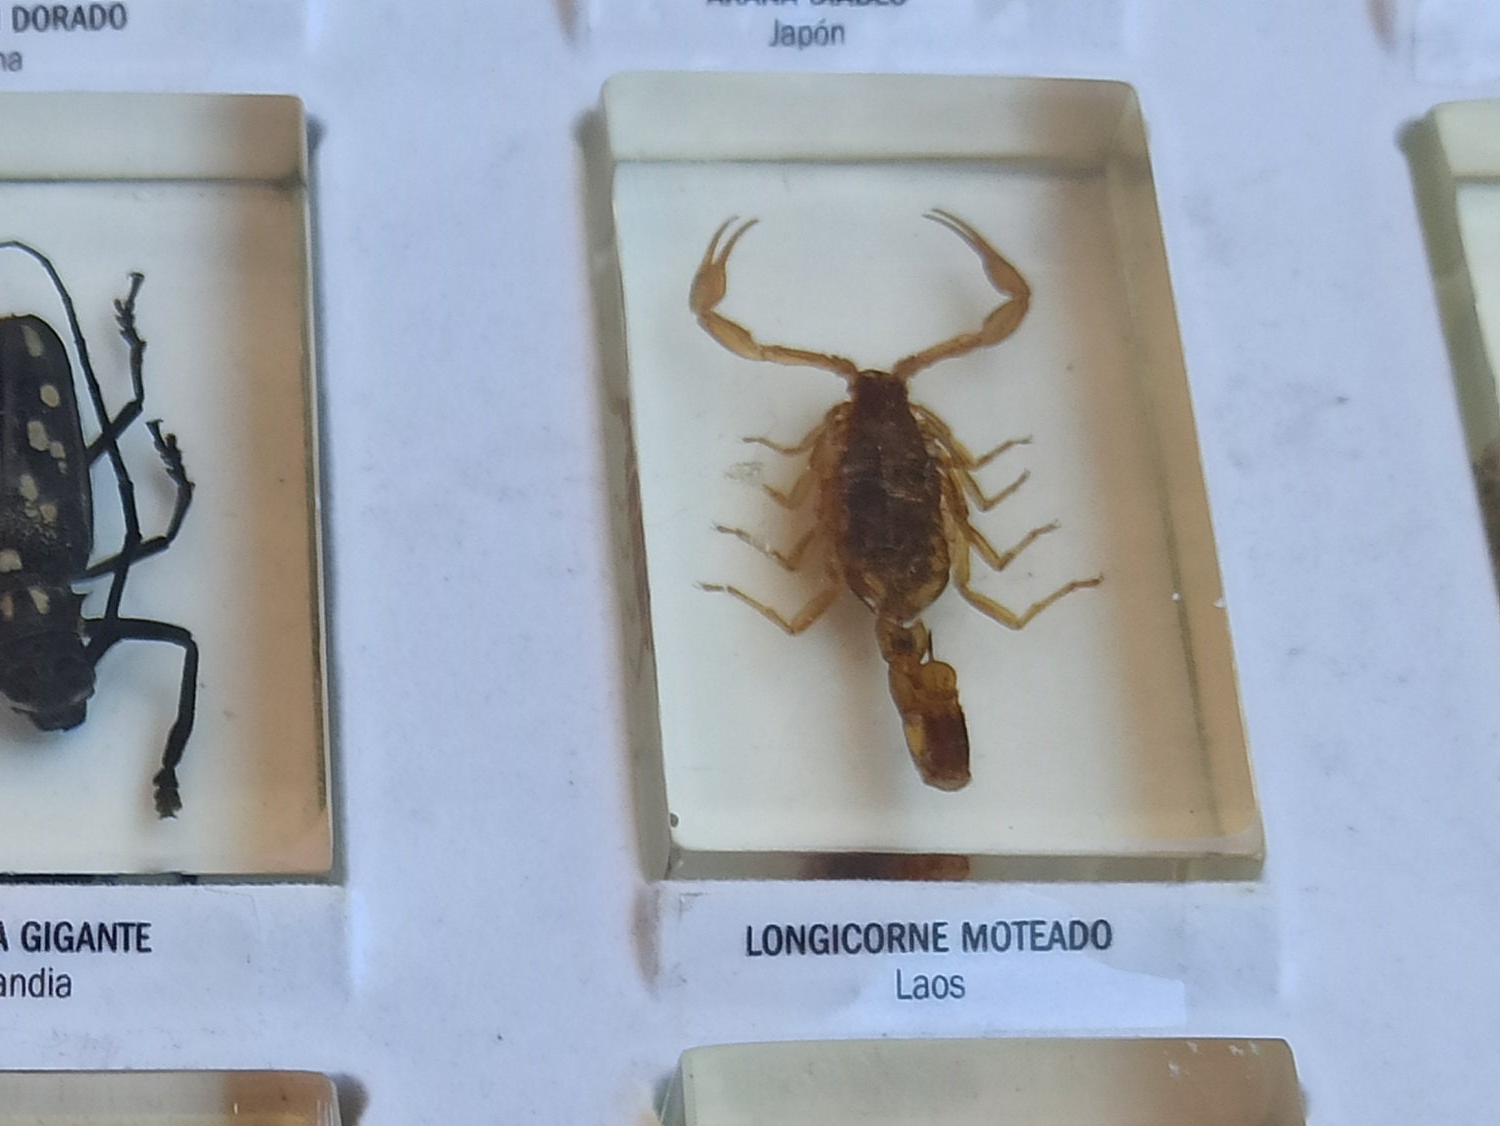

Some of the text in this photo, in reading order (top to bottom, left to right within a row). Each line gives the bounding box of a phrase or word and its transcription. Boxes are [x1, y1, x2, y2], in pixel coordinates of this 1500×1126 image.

[11, 3, 128, 33] DORADO
[769, 18, 846, 49] Japón
[20, 920, 153, 953] GIGANTE
[745, 919, 1113, 956] LONGICORNE MOTEADO
[896, 968, 966, 1000] Laos
